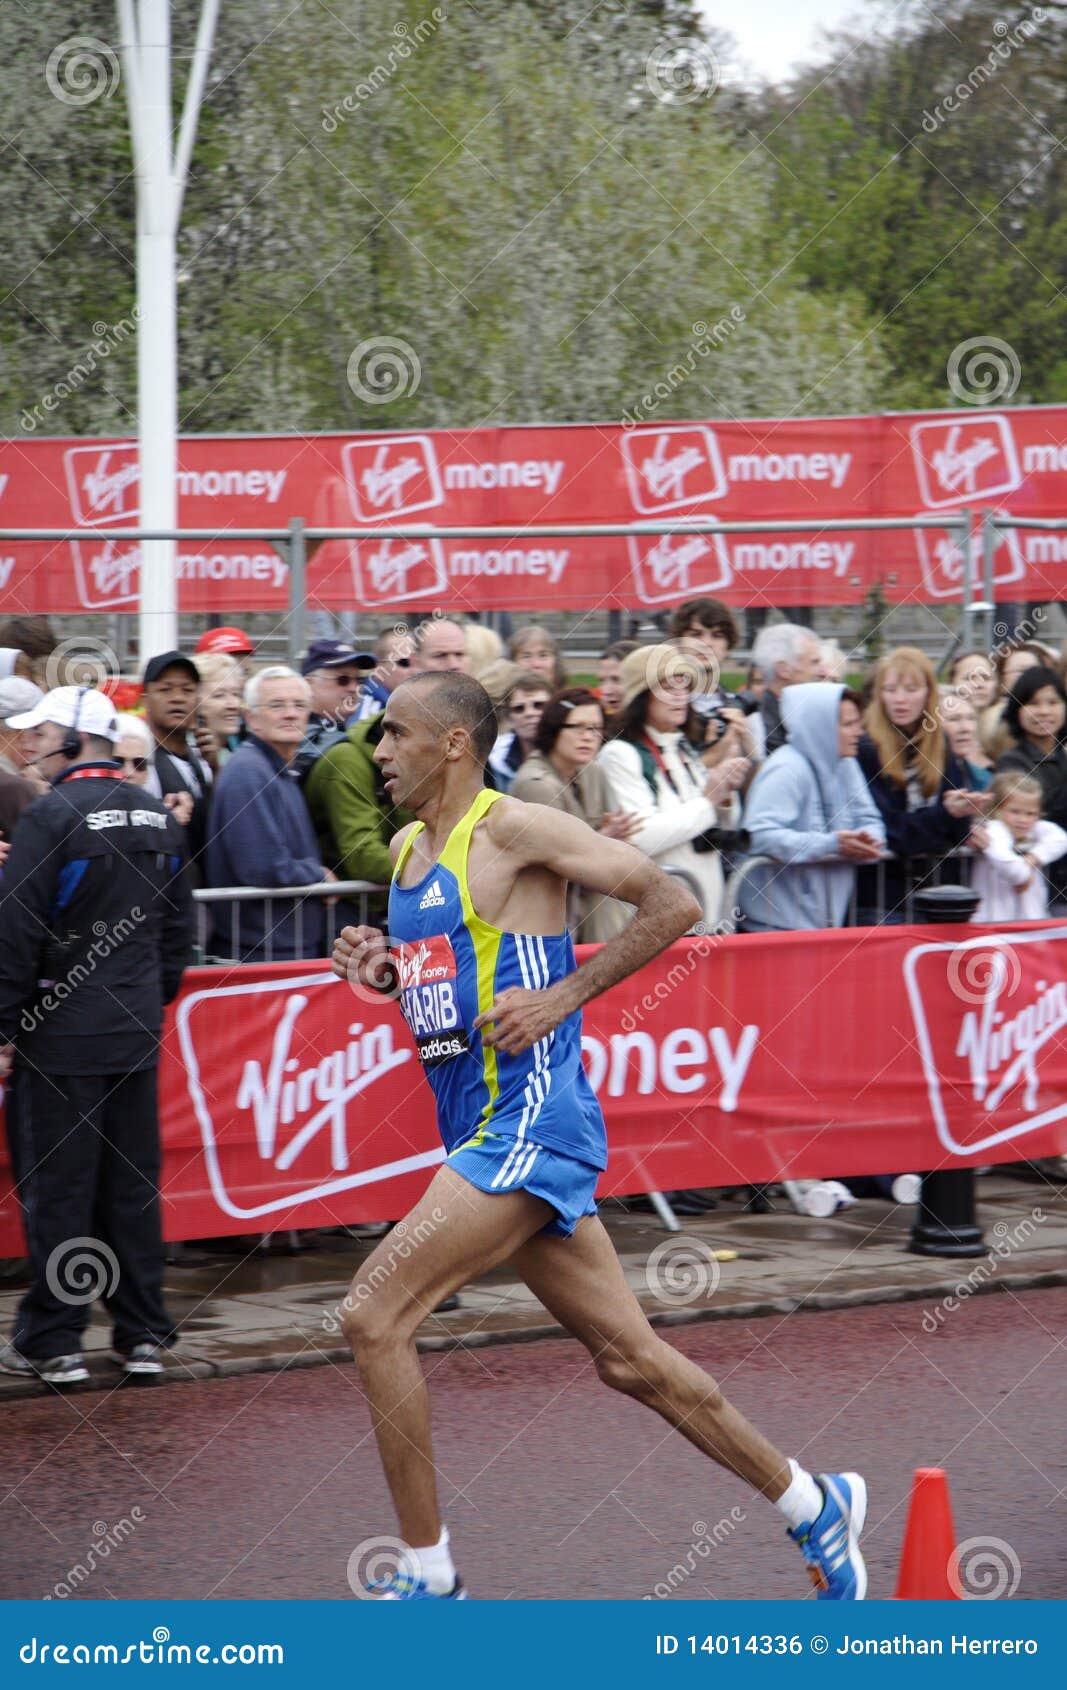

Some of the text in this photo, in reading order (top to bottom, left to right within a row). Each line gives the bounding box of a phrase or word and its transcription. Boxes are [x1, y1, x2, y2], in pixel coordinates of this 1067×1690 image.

[445, 460, 565, 495] money
[729, 452, 852, 489] money
[449, 549, 571, 583] money
[734, 540, 856, 577] money
[401, 981, 458, 1036] HARIB
[236, 994, 412, 1170] Virgin
